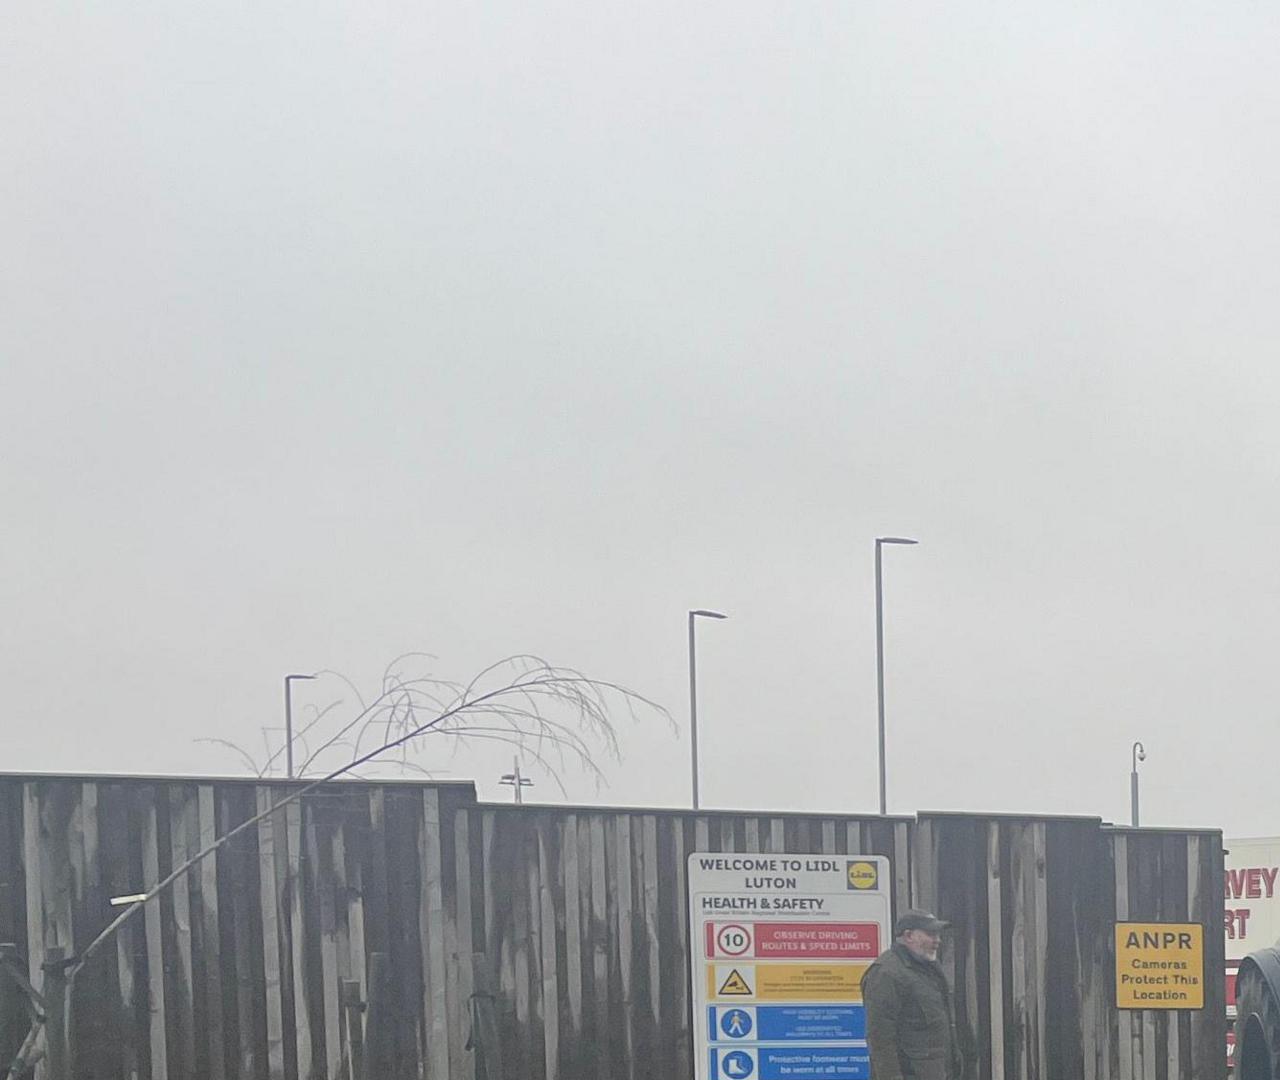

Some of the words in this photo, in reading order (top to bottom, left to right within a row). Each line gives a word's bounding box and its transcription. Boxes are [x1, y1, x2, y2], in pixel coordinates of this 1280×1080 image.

[700, 859, 777, 871] WELCOME
[781, 860, 802, 871] TO
[806, 861, 840, 872] LIDL
[745, 877, 796, 888] LUTON
[702, 897, 757, 909] HEALTH
[760, 898, 771, 909] &
[773, 898, 824, 910] SAFETY
[724, 933, 744, 947] 10
[773, 931, 817, 940] OBSERVE
[818, 931, 858, 940] DRIVING
[1126, 931, 1192, 950] ANPR
[762, 942, 798, 951] ROUTES
[809, 942, 839, 951] SPEED
[840, 942, 871, 951] LIMITS
[1131, 959, 1188, 970] Cameras
[1121, 974, 1169, 985] Protect
[1173, 974, 1199, 985] This
[1133, 989, 1188, 1001] Location
